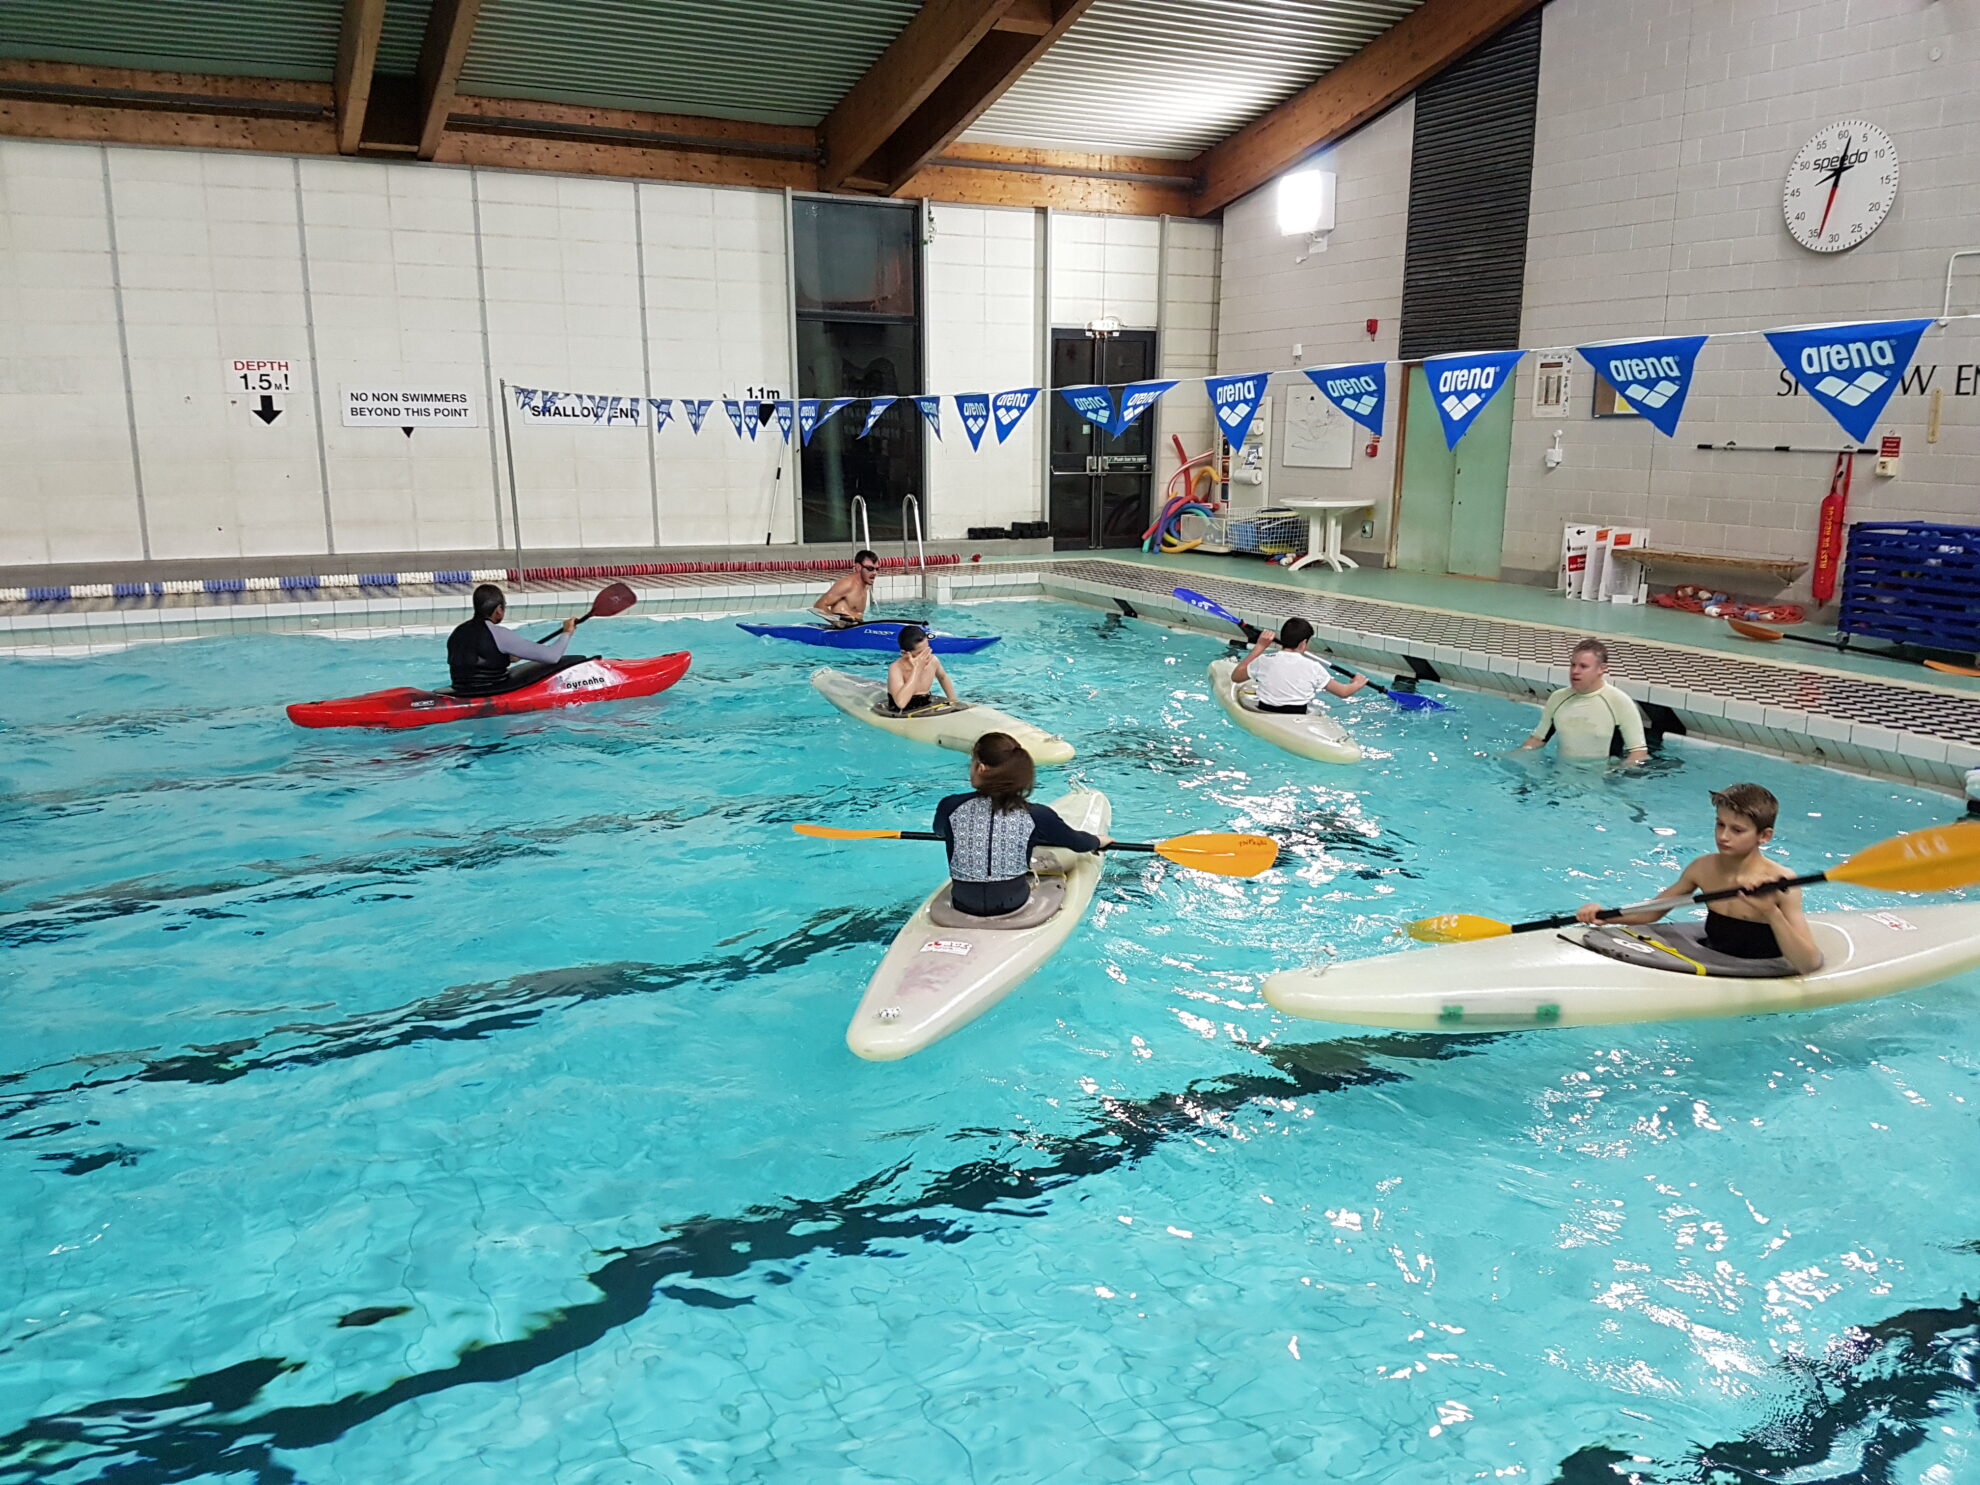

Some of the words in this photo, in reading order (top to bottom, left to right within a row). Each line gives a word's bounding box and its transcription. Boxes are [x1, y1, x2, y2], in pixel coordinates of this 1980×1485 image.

[1837, 129, 1849, 140] 60
[1862, 133, 1868, 142] 5
[1816, 140, 1827, 150] 55
[1874, 149, 1885, 159] 10
[1799, 161, 1810, 171] 50
[1812, 149, 1868, 172] speedo
[1880, 175, 1891, 185] 15
[1790, 188, 1801, 198] 45
[1868, 202, 1880, 212] 20
[1794, 211, 1806, 221] 40
[1808, 228, 1819, 239] 35
[1850, 223, 1863, 233] 25
[1828, 233, 1840, 243] 30
[1800, 340, 1896, 375] arena
[233, 360, 289, 371] DEPTH
[1609, 356, 1681, 382] arena
[1438, 366, 1496, 393] arena
[1216, 380, 1256, 404] arena
[1326, 375, 1377, 398] arena
[350, 392, 368, 402] NO
[372, 392, 398, 402] NON
[402, 393, 467, 403] SWIMMERS
[746, 387, 780, 399] 1.1m
[996, 393, 1028, 408] arena
[1074, 395, 1107, 411] arena
[350, 407, 401, 417] BEYOND
[404, 407, 431, 417] THIS
[434, 408, 469, 417] POINT
[964, 402, 987, 416] arena
[566, 676, 605, 689] pyranha
